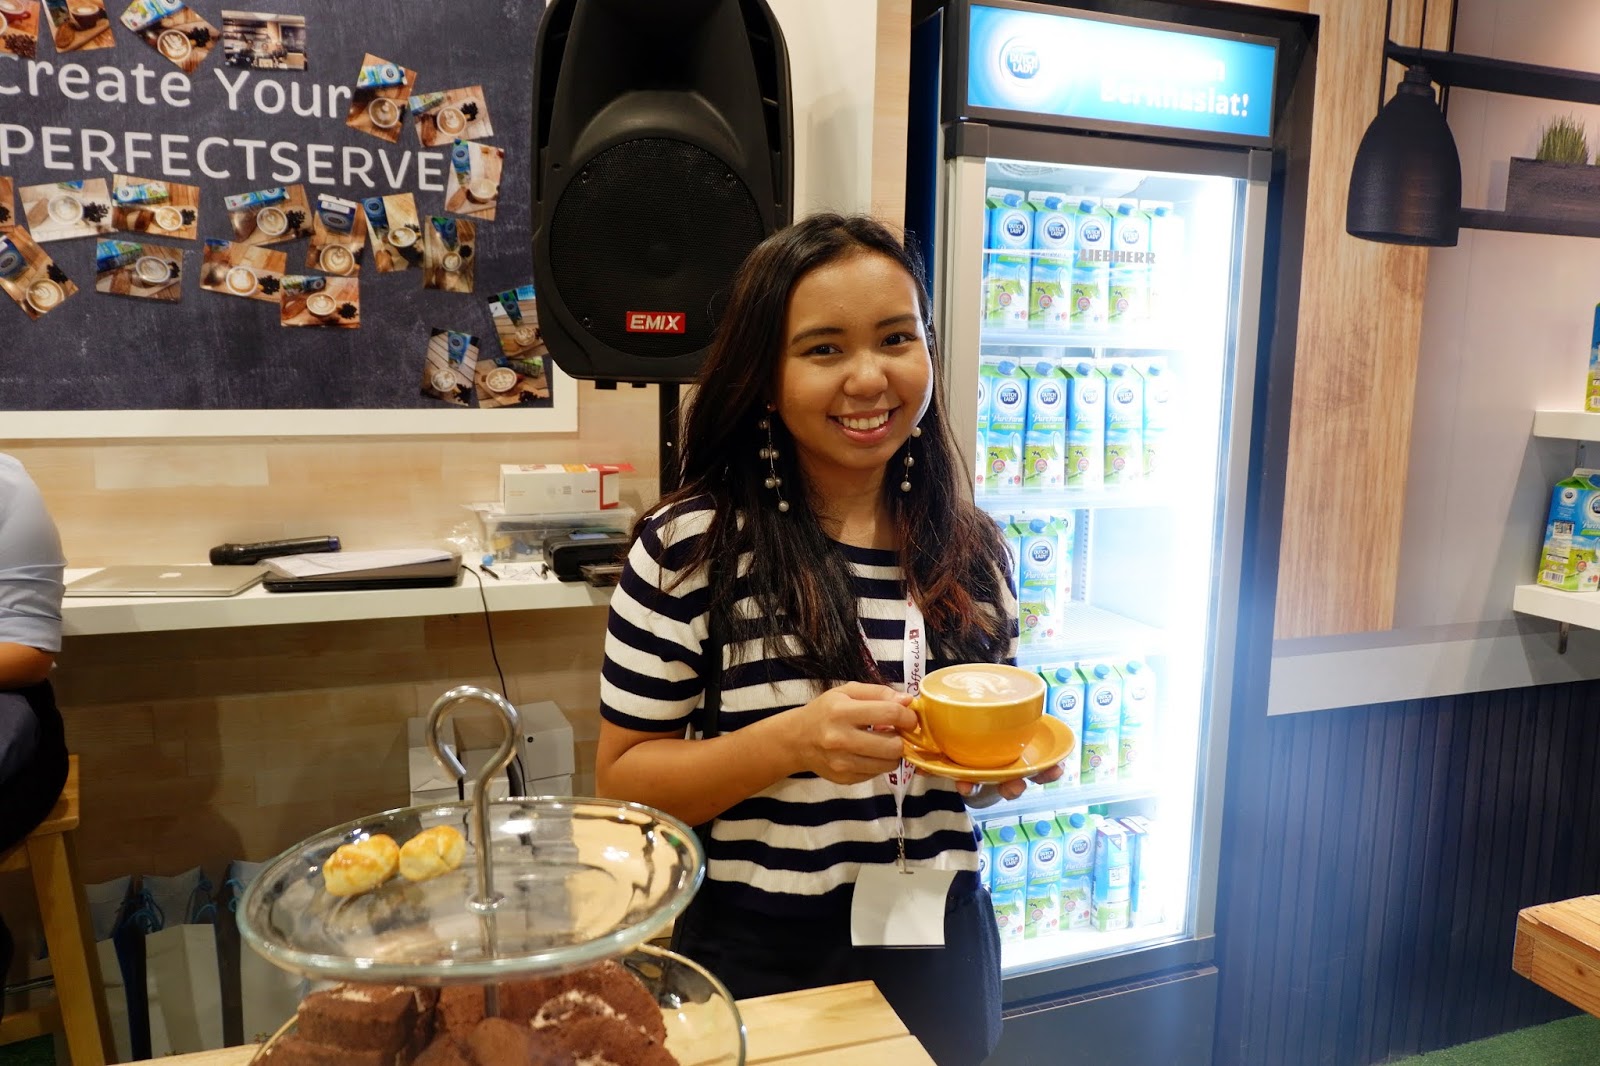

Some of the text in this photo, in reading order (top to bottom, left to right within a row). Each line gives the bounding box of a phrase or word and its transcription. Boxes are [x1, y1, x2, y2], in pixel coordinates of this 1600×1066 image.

[1012, 62, 1034, 74] LADY
[213, 67, 351, 118] Your
[0, 123, 444, 192] PERFECTSERVE
[1080, 249, 1156, 264] LIEBHERR
[630, 314, 681, 331] EMIX
